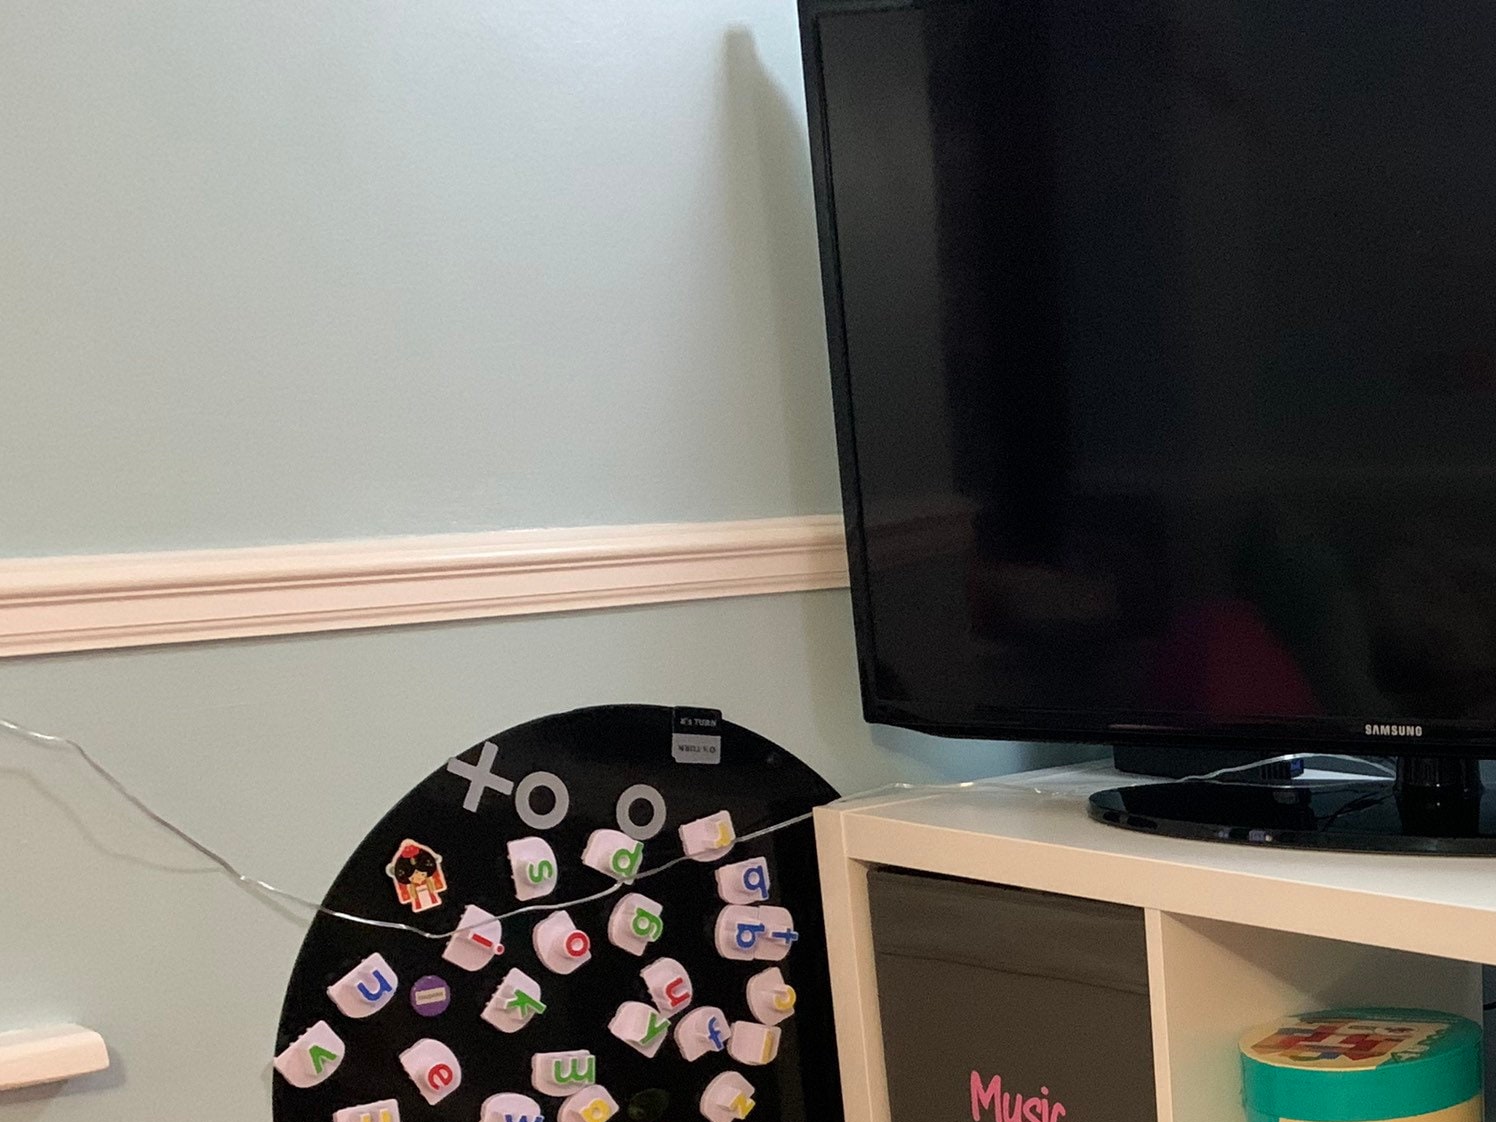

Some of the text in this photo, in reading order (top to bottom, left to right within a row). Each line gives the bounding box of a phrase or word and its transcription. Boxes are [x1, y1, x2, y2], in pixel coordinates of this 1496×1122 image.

[1364, 724, 1423, 737] SAMSUNG
[528, 859, 554, 884] s
[611, 841, 645, 877] d
[632, 907, 664, 938] g
[770, 928, 800, 946] t
[565, 931, 589, 958] o
[511, 988, 547, 1018] k
[639, 1011, 672, 1046] y
[707, 1016, 725, 1051] f
[428, 1063, 455, 1091] e
